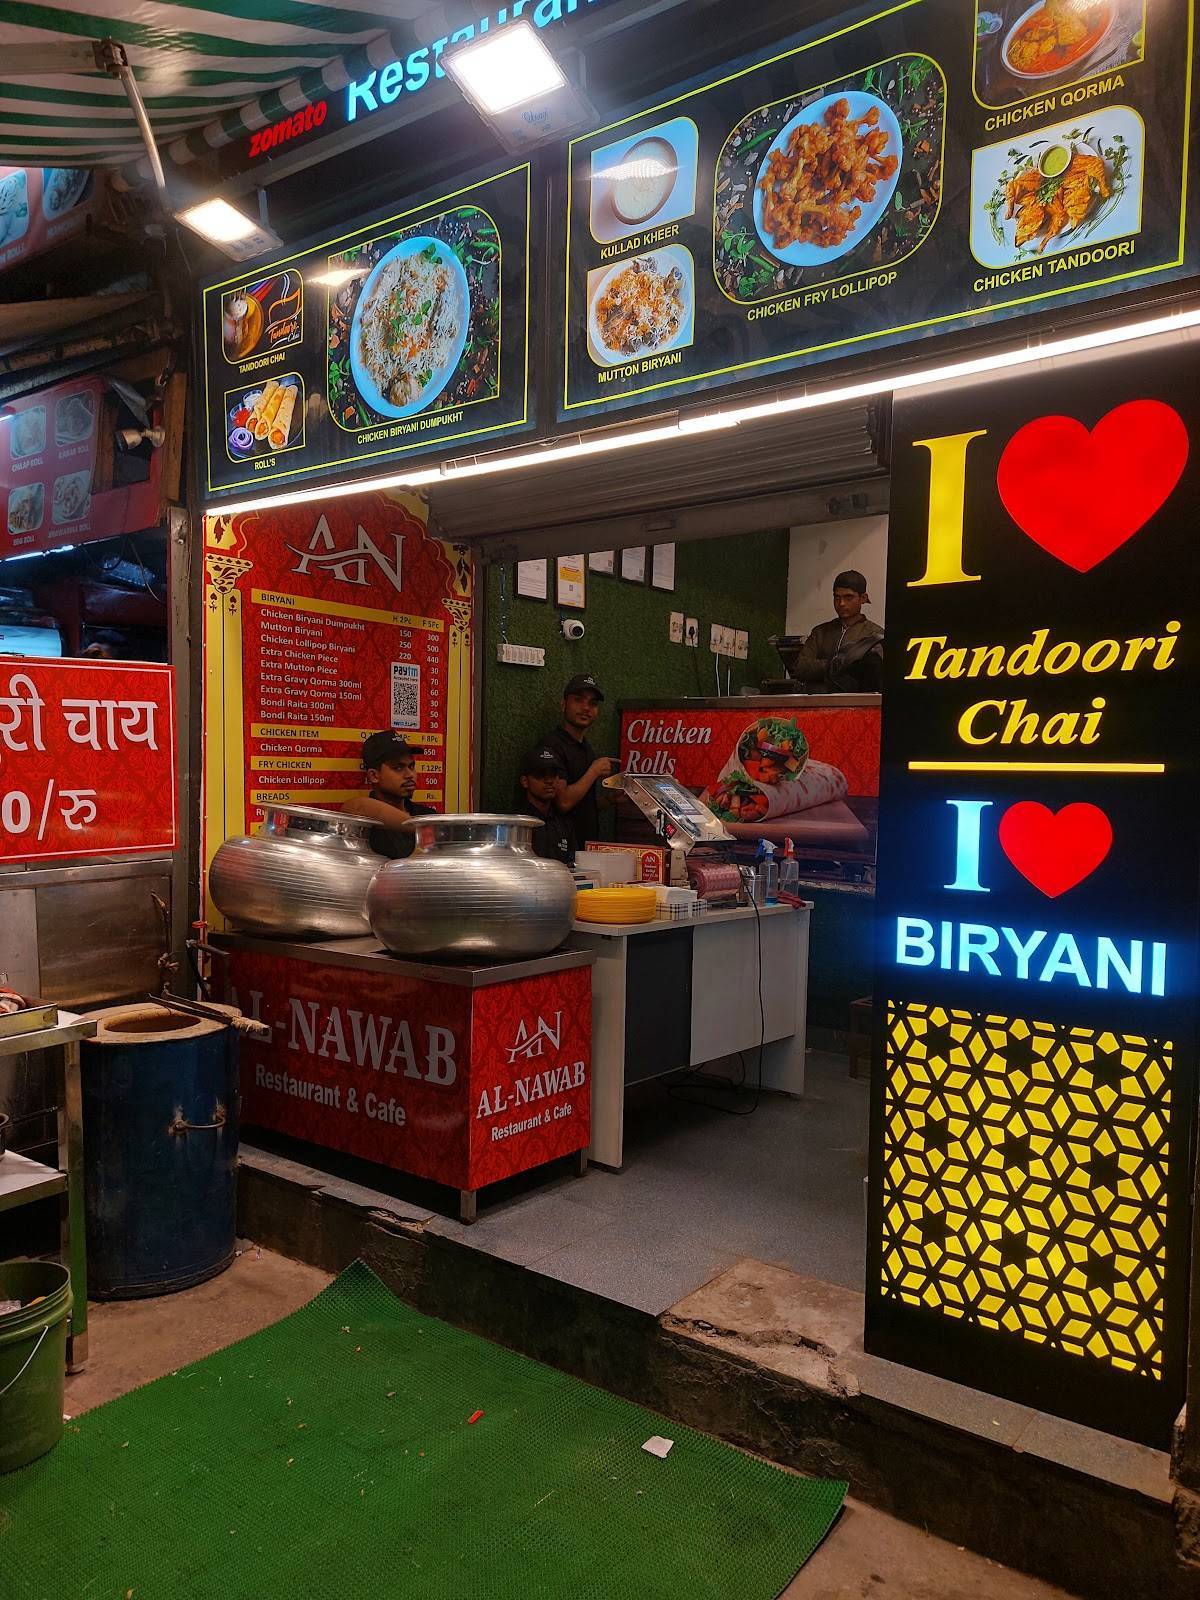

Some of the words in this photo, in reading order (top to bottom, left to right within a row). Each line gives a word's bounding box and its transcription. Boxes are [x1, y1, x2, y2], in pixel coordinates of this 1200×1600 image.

[984, 97, 1057, 132] CHICKEN
[1060, 74, 1126, 107] QORMA
[248, 100, 328, 158] zomato
[600, 233, 640, 260] KULLAD
[642, 223, 681, 250] KHEER
[973, 262, 1045, 294] CHICKEN
[1047, 239, 1136, 274] TANDOORI
[746, 297, 801, 322] CHICKEN
[803, 291, 829, 309] FRY
[831, 271, 898, 300] LOLLIPOP
[239, 357, 270, 374] TANDOORI
[270, 352, 286, 364] CHAI
[597, 360, 639, 384] MUTTON
[641, 351, 683, 375] BIRYANI
[357, 428, 388, 445] CHICKEN
[390, 422, 419, 438] BIRYANI
[420, 411, 464, 430] DUMPUKHT
[254, 458, 277, 471] ROLL'S
[906, 429, 989, 587] I
[261, 593, 295, 606] BIRYANI
[261, 608, 294, 621] Chicken
[295, 614, 324, 625] Biryani
[325, 618, 365, 631] Dumpukht
[400, 629, 412, 638] 150
[428, 634, 440, 642] 300
[261, 621, 293, 633] Mutton
[295, 625, 323, 637] Biryani
[400, 641, 412, 649] 250
[427, 645, 439, 653] 500
[261, 634, 294, 646] Chicken
[295, 638, 328, 651] Lollipop
[329, 642, 356, 654] Biryani
[399, 652, 412, 660] 220
[427, 656, 439, 664] 440
[261, 646, 283, 656] Extra
[284, 649, 316, 661] Chicken
[318, 653, 339, 663] Piece
[431, 667, 439, 675] 30
[903, 620, 1182, 682] Tandoori
[261, 659, 283, 669] Extra
[284, 662, 315, 673] Mutton
[317, 666, 338, 675] Piece
[261, 672, 282, 681] Extra
[284, 674, 308, 686] Gravy
[309, 678, 337, 687] Qorma
[338, 679, 362, 689] 300ml
[430, 689, 439, 697] 60
[261, 685, 282, 694] Extra
[284, 687, 308, 698] Gravy
[309, 690, 337, 699] Qorma
[339, 691, 362, 701] 150ml
[430, 700, 439, 708] 30
[261, 697, 285, 707] Bondi
[287, 700, 308, 709] Raita
[309, 701, 335, 711] 300ml
[430, 711, 439, 719] 50
[261, 710, 285, 719] Bondi
[287, 712, 308, 721] Raita
[310, 713, 335, 722] 150ml
[430, 721, 439, 729] 30
[957, 696, 1106, 746] Chai
[61, 698, 159, 751] चाय
[260, 727, 297, 737] CHICKEN
[299, 729, 320, 738] ITEM
[627, 719, 713, 745] Chicken
[260, 743, 293, 752] Chicken
[294, 744, 323, 753] Qorma
[625, 750, 677, 775] Rolls
[258, 760, 274, 769] FRY
[276, 761, 312, 769] CHICKEN
[258, 775, 292, 784] Chicken
[293, 775, 325, 785] Lollipop
[425, 777, 438, 785] 500
[256, 792, 290, 801] BREADS
[943, 800, 994, 892] I
[895, 916, 1168, 998] BIRYANI
[255, 1063, 342, 1110] Restaurant
[346, 1086, 360, 1114] &
[365, 1090, 407, 1128] Cafe
[476, 1060, 586, 1120] AL-NAWAB
[491, 1113, 542, 1142] Restaurant
[543, 1108, 552, 1123] &
[553, 1102, 573, 1119] Cafe
